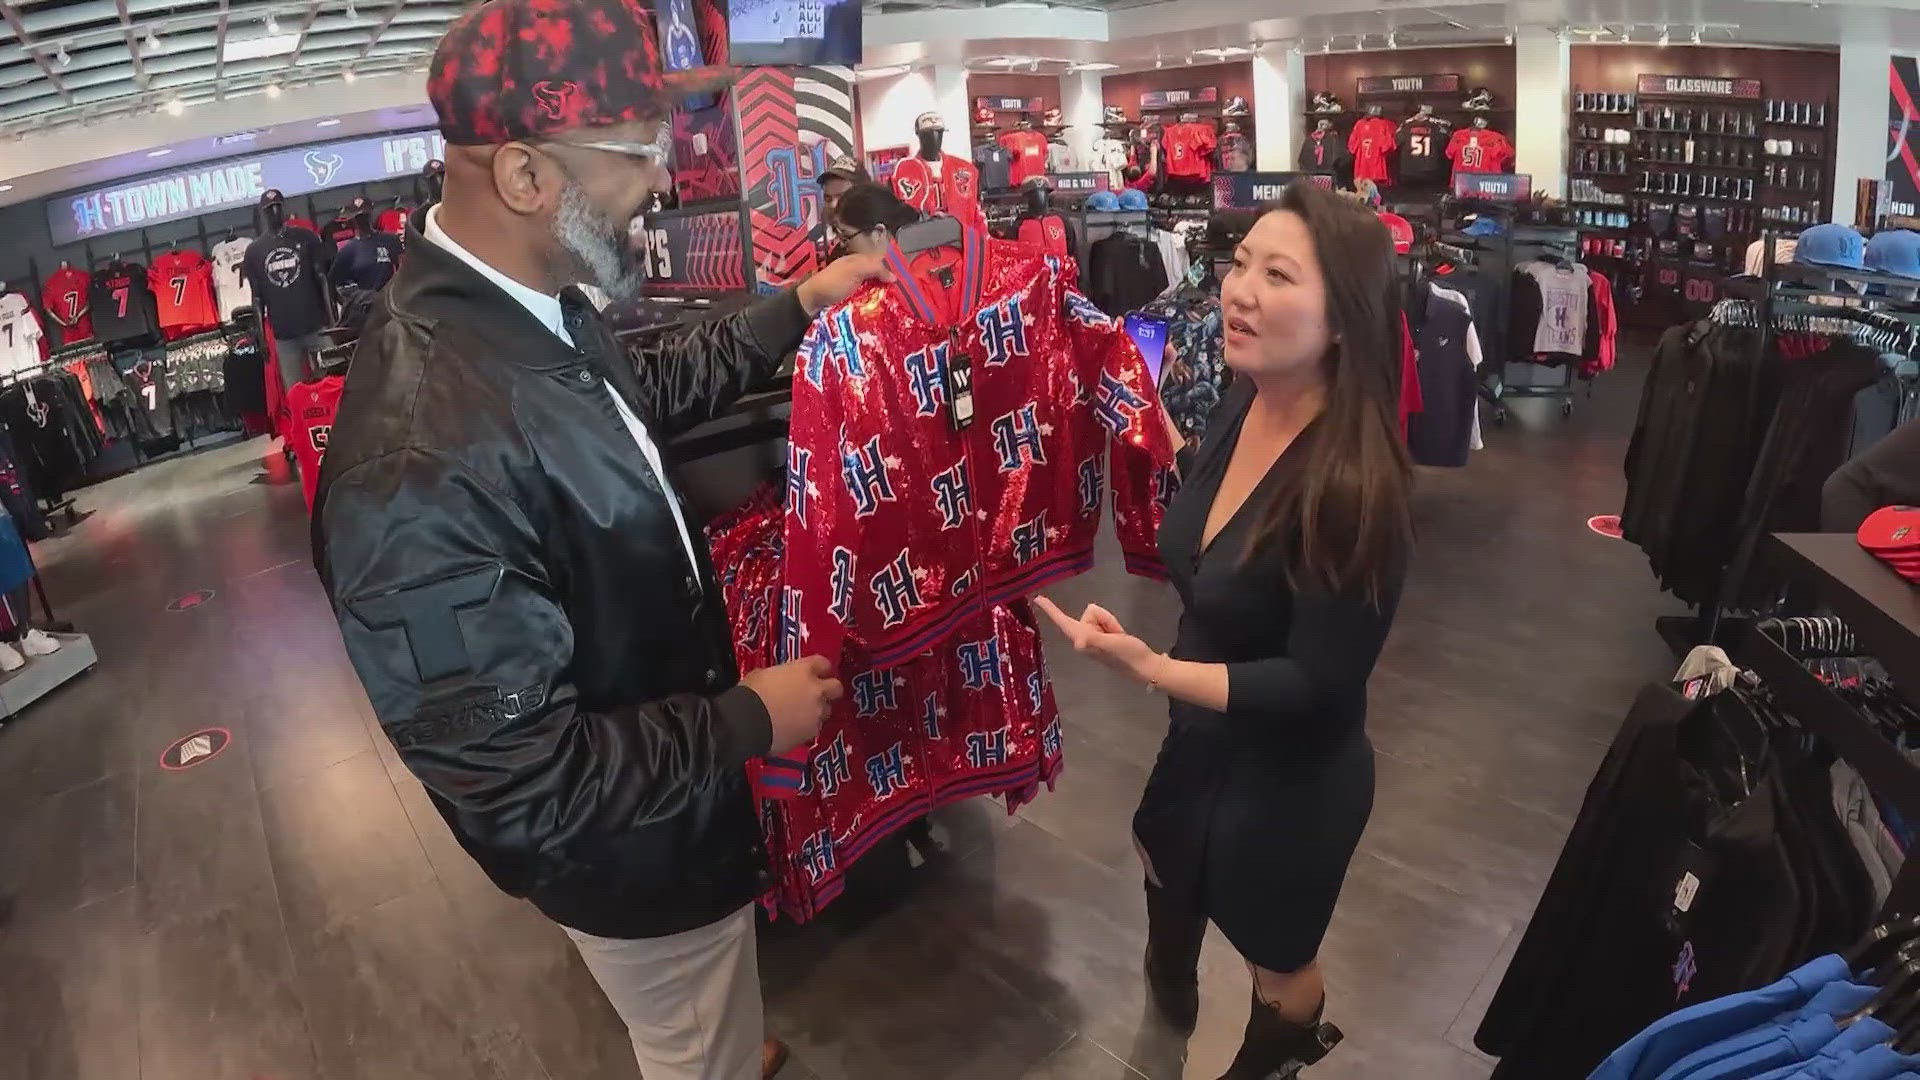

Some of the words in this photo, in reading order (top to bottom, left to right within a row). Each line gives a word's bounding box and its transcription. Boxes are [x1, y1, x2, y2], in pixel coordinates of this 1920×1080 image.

[1392, 78, 1423, 90] YOUTH
[1666, 78, 1732, 95] GLASSWARE
[1001, 99, 1022, 109] YOUTH
[1166, 90, 1190, 103] YOUTH
[1409, 134, 1431, 157] 51
[1462, 144, 1484, 168] 51
[1080, 178, 1096, 188] TALL
[1252, 184, 1289, 200] MEN'
[1479, 181, 1508, 194] YOUTH
[106, 177, 189, 227] TOWN
[190, 162, 264, 209] MADE
[1892, 201, 1915, 216] HOU
[170, 275, 187, 306] 7
[64, 291, 78, 319] 7
[112, 287, 128, 318] 7
[2, 323, 13, 348] 7
[141, 385, 157, 410] 7
